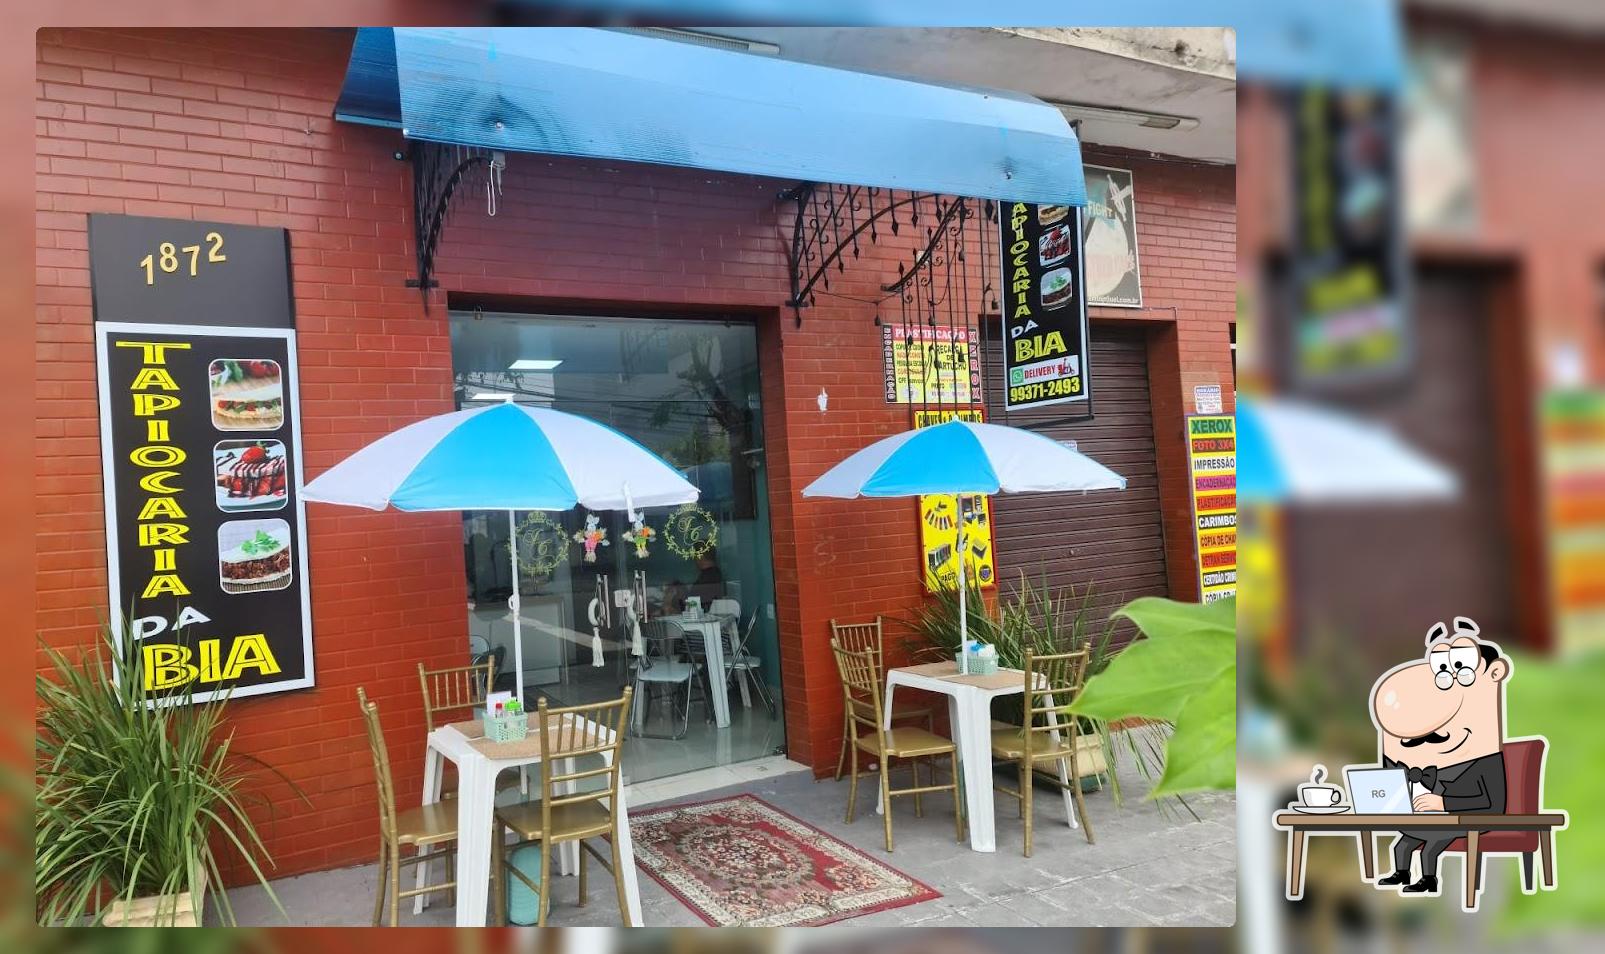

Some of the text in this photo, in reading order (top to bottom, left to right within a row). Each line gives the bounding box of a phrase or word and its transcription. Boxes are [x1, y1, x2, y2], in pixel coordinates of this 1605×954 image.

[140, 232, 226, 285] 1872
[1010, 202, 1031, 318] APIOCARIA
[1011, 319, 1039, 339] DA
[1015, 330, 1067, 363] BIA
[1024, 365, 1056, 379] DELIVERY
[1010, 377, 1080, 402] 99371-2493
[1191, 419, 1233, 434] XEROX
[1193, 440, 1216, 451] FOTO
[115, 341, 193, 599] TAPIOCARIA
[1194, 456, 1235, 470] IMPRESSÃO
[133, 606, 211, 640] DA
[143, 633, 282, 690] BIA
